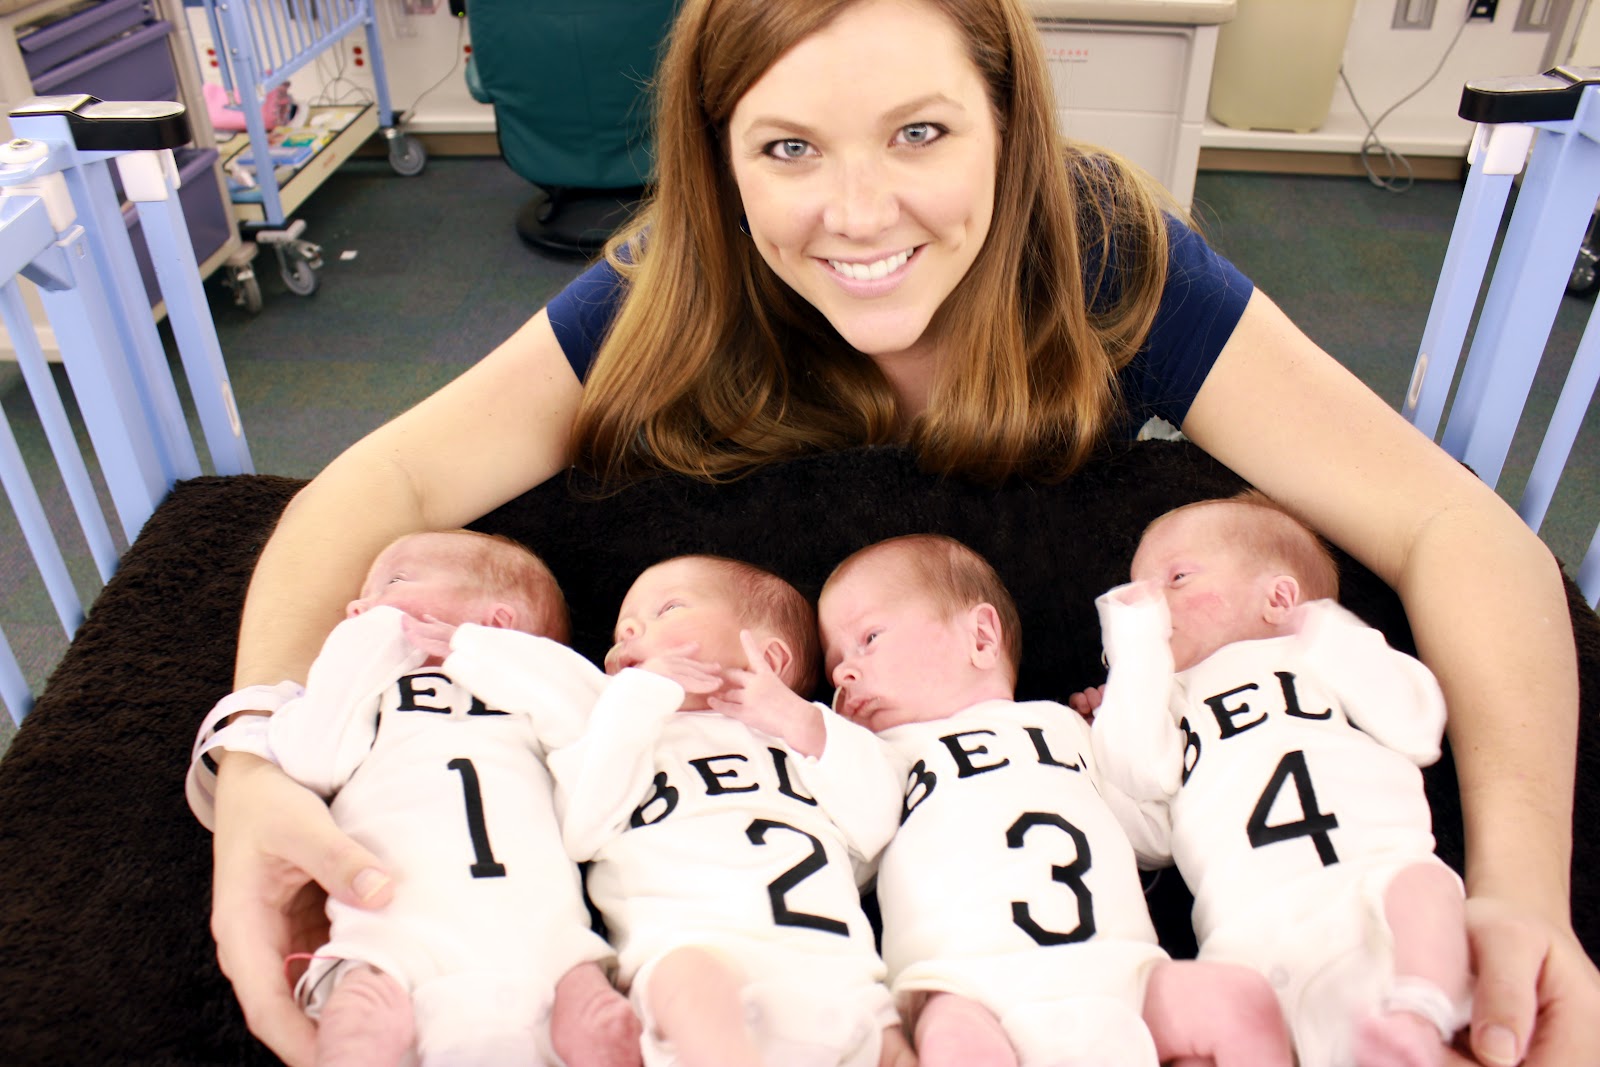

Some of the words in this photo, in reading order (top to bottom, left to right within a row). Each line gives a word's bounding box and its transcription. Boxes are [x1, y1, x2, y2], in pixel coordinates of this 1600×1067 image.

[447, 758, 507, 879] 1
[1246, 749, 1339, 867] 4
[745, 818, 850, 937] 2
[1005, 811, 1097, 947] 3
